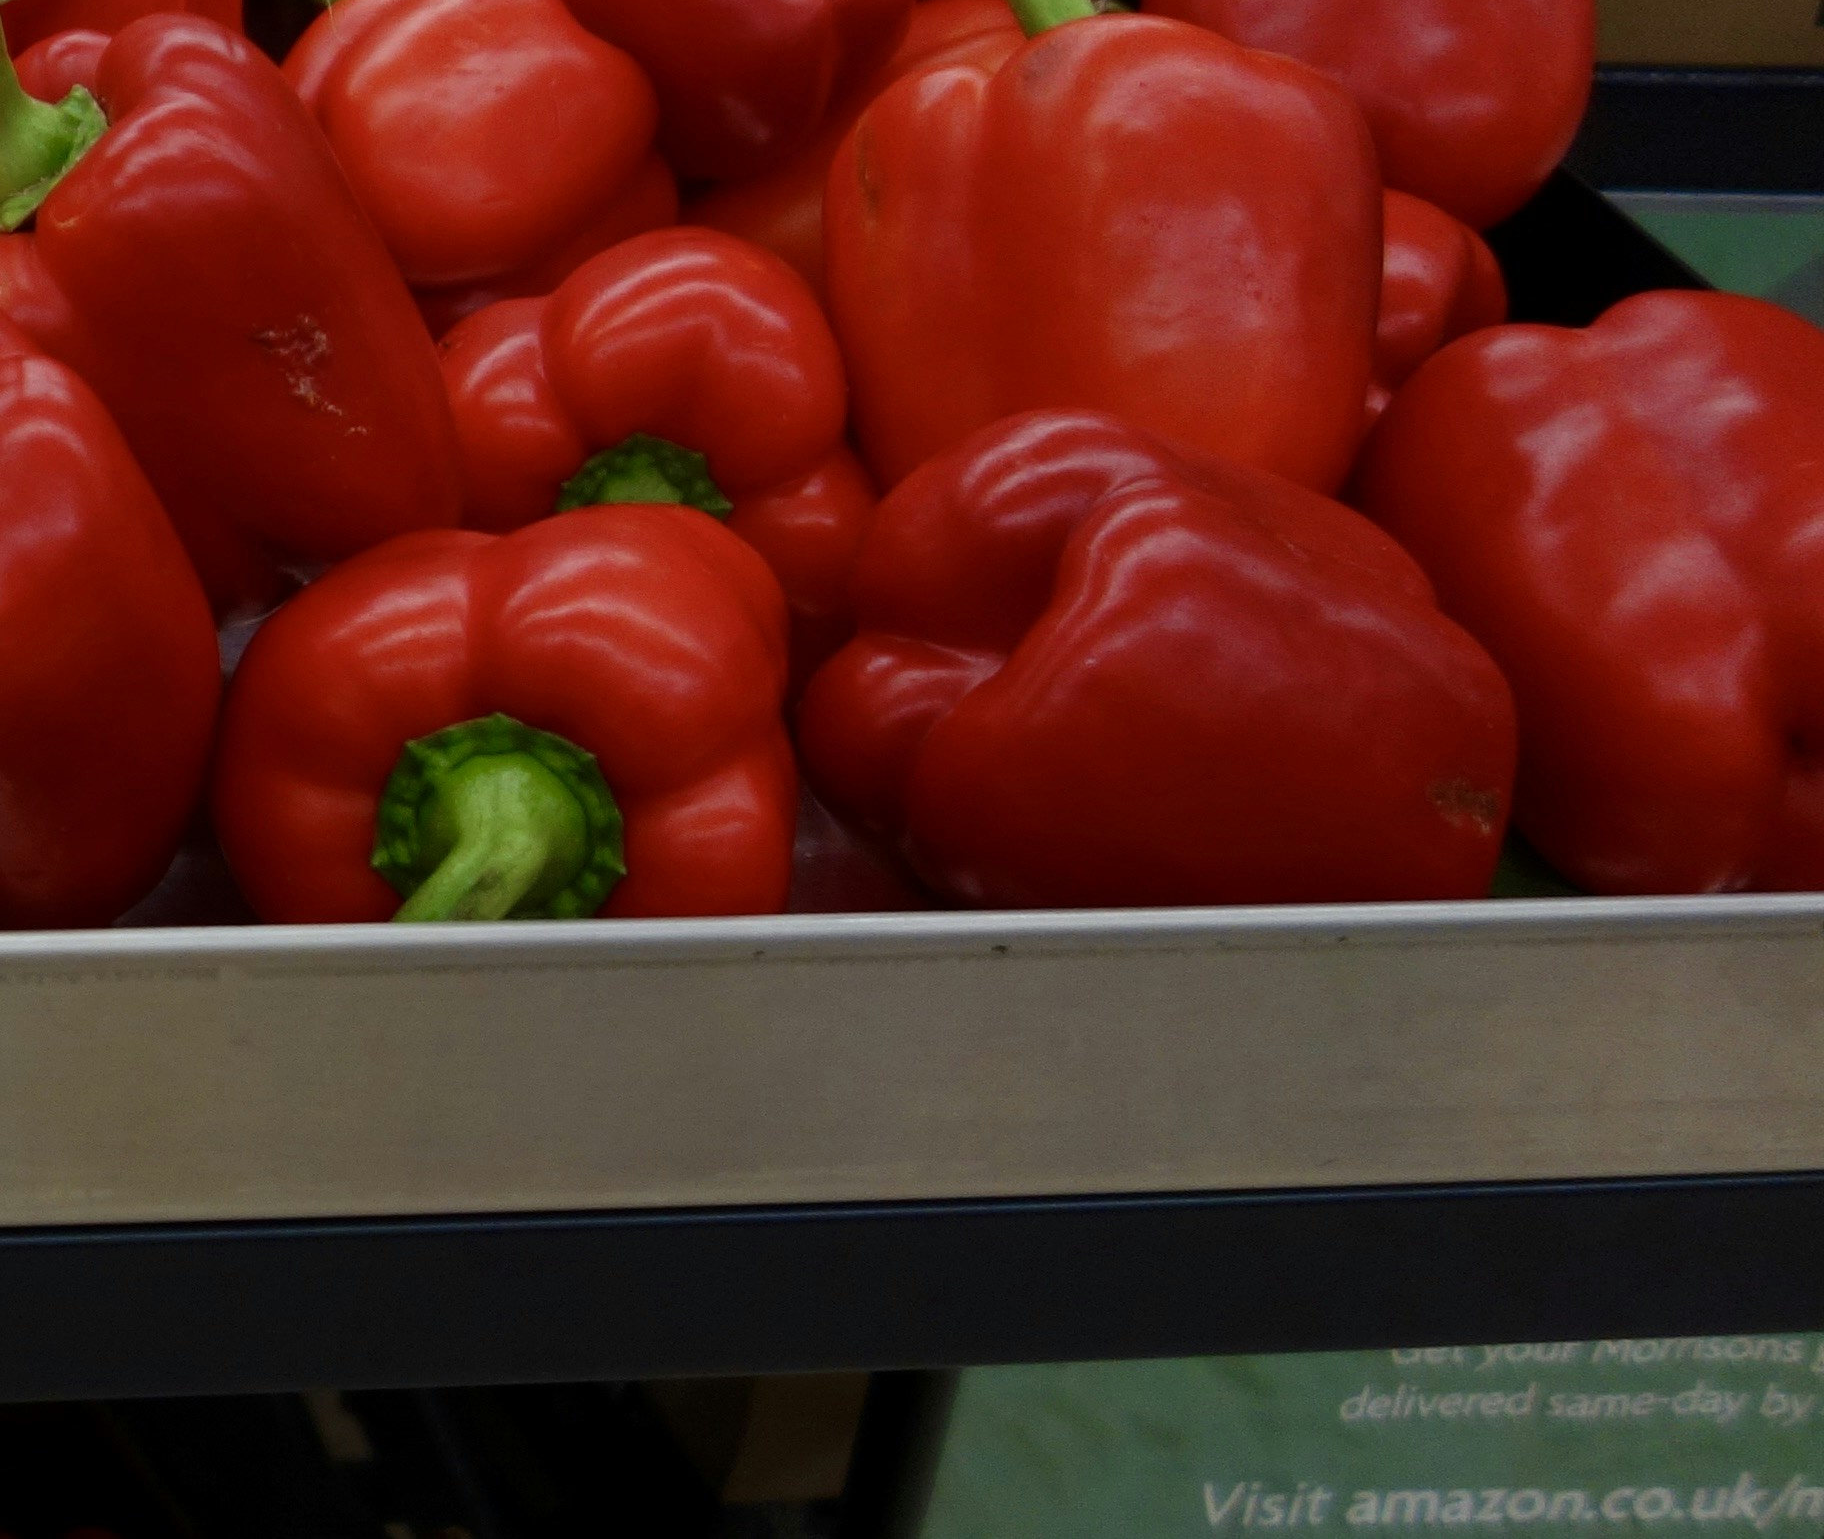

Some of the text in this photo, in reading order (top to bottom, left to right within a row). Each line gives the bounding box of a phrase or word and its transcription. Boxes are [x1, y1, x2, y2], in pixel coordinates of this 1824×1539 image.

[1339, 1379, 1817, 1427] delivered same-day by
[1202, 1481, 1333, 1527] Visit
